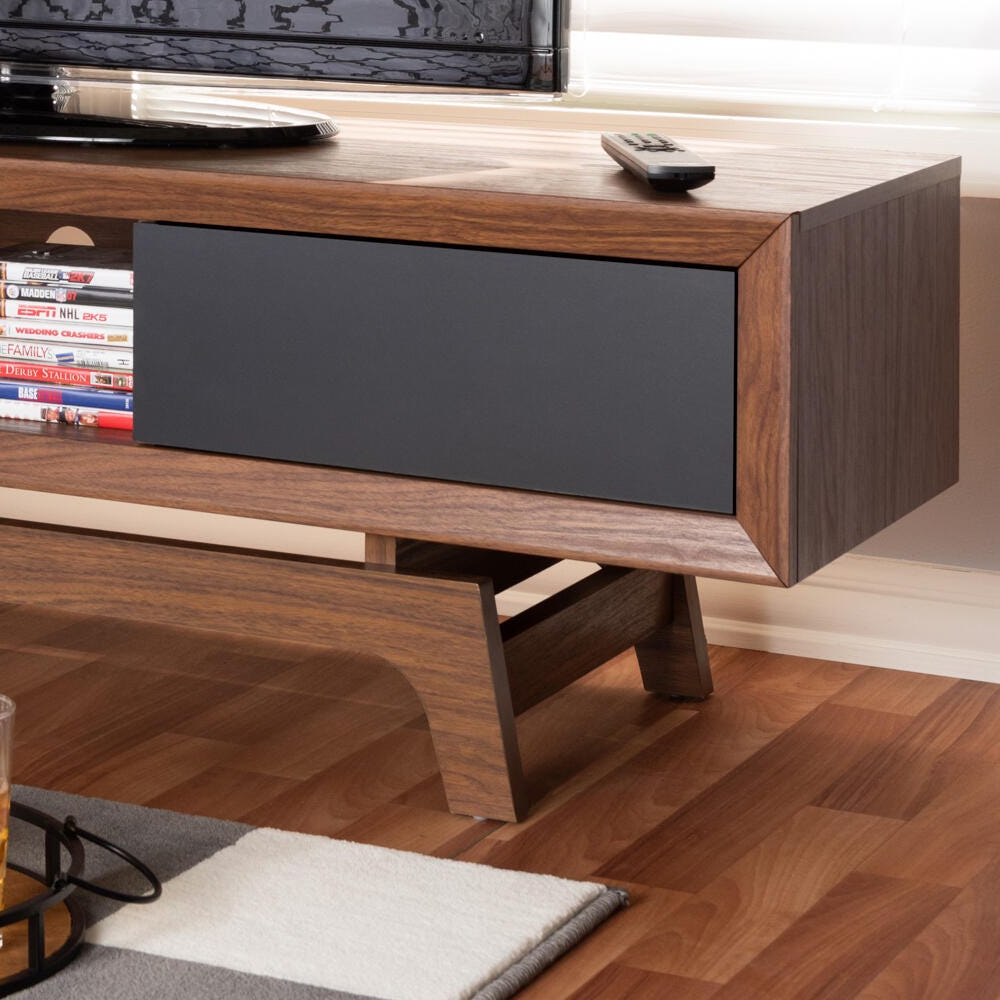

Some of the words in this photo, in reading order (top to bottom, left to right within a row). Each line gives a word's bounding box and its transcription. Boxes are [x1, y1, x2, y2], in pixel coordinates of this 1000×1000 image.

[21, 287, 56, 300] MADDEN
[60, 307, 80, 320] NHL
[82, 312, 108, 322] 2K5
[15, 327, 59, 337] WEDDING
[60, 330, 105, 340] CRASHERS
[5, 364, 39, 378] DERBY
[41, 367, 87, 383] STALLION
